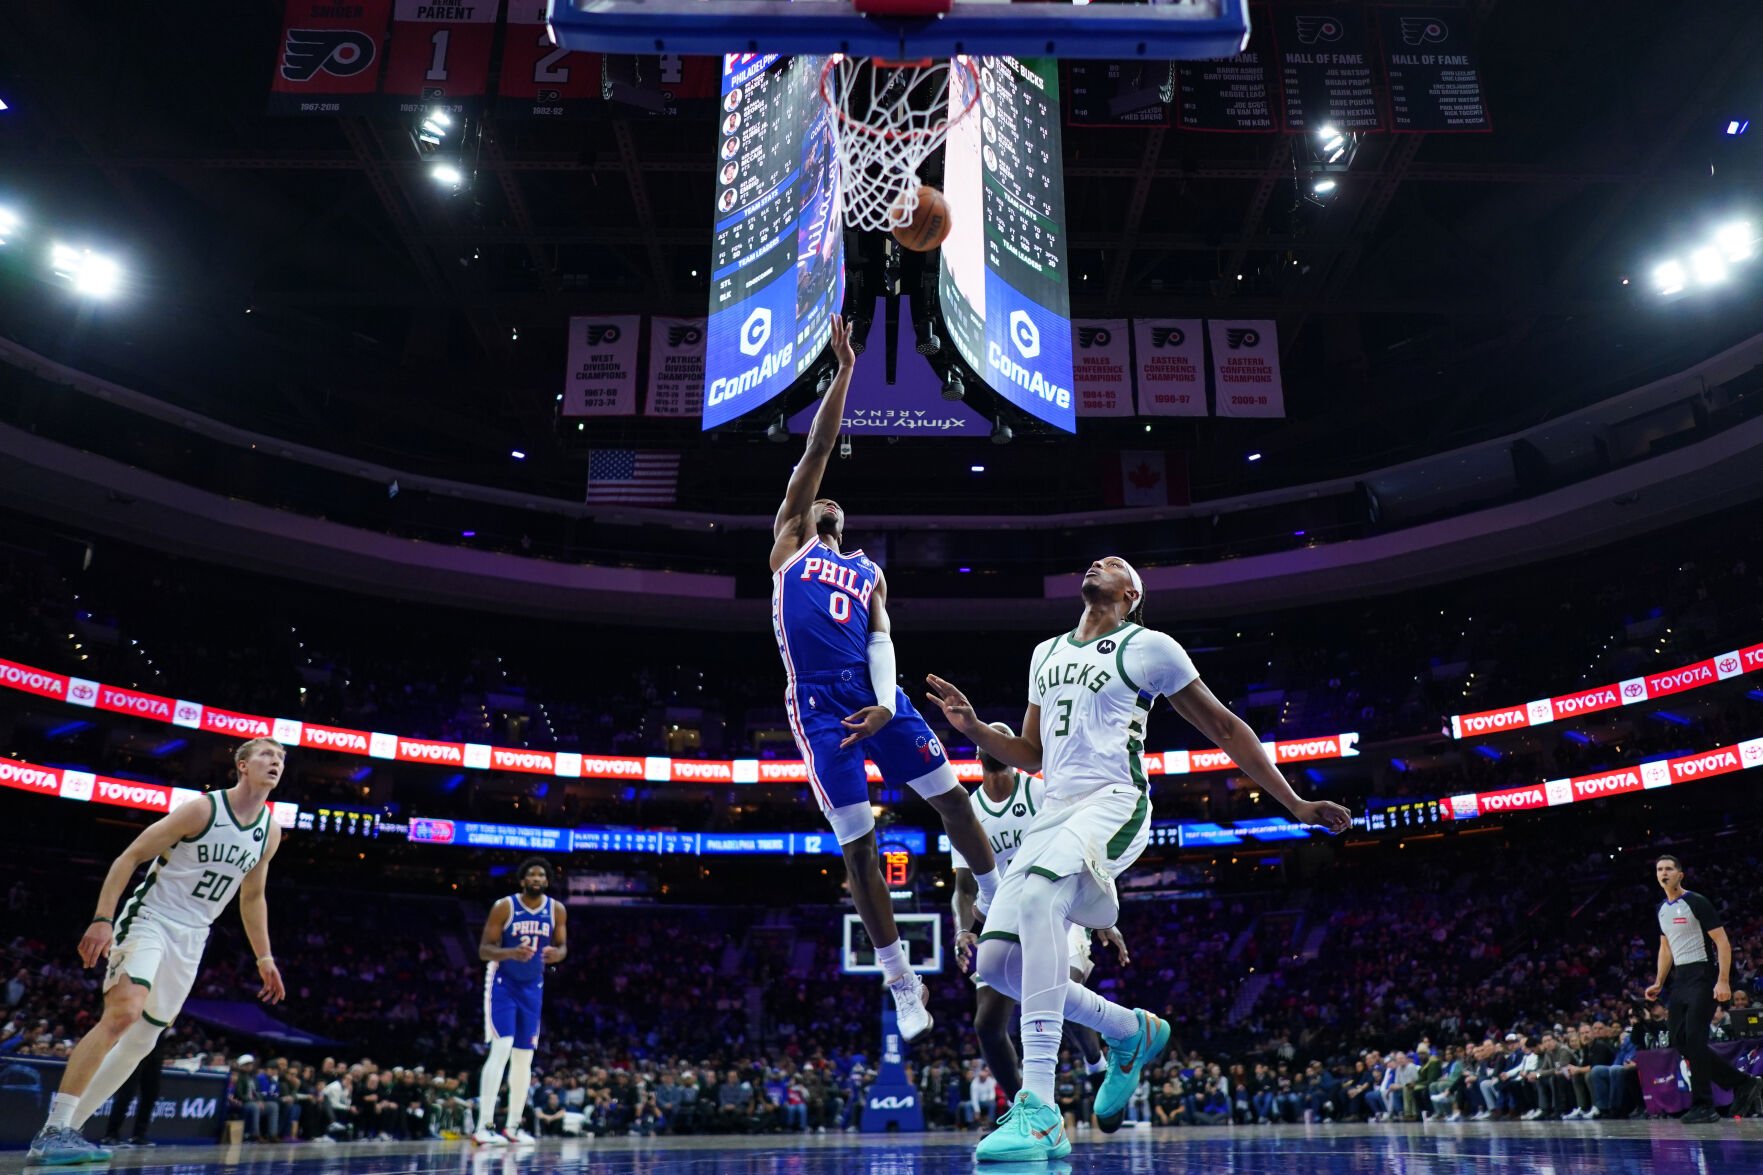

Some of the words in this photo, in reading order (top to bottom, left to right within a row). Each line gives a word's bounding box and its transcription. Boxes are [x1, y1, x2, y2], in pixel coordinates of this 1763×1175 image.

[417, 6, 475, 19] PARENT
[425, 30, 449, 81] 1
[1286, 53, 1314, 63] HALL
[1316, 53, 1330, 64] OF
[1332, 54, 1364, 64] FAME
[1391, 54, 1419, 65] HALL
[1421, 55, 1436, 65] OF
[1438, 55, 1469, 65] FAME
[1020, 64, 1044, 90] BUCKS
[301, 103, 340, 111] 1967-2016
[533, 107, 563, 115] 1982-92
[743, 101, 765, 118] GEORGE
[744, 202, 761, 217] TEAM
[761, 188, 779, 207] STATS
[1003, 191, 1019, 209] TEAM
[1019, 204, 1037, 221] STATS
[718, 231, 729, 240] AST
[1020, 216, 1028, 226] BLK
[1047, 233, 1055, 242] FLS
[719, 252, 726, 260] FG
[738, 253, 756, 268] TEAM
[755, 236, 780, 258] LEADERS
[989, 240, 999, 254] STL
[1003, 239, 1018, 257] TEAM
[1018, 251, 1043, 272] LEADERS
[1020, 242, 1030, 253] 100
[1048, 259, 1056, 268] 20
[990, 253, 1000, 267] BLK
[720, 278, 732, 289] STL
[719, 290, 732, 302] BLK
[583, 363, 621, 371] DIVISION
[591, 354, 614, 362] WEST
[1083, 357, 1110, 365] WALES
[1151, 356, 1189, 365] EASTERN
[1227, 358, 1264, 366] EASTERN
[576, 372, 627, 380] CHAMPIONS
[665, 364, 702, 372] DIVISION
[707, 342, 793, 407] ComAve
[988, 341, 1070, 409] ComAve
[1144, 365, 1197, 373] CONFERENCE
[1220, 366, 1272, 374] CONFERENCE
[1073, 374, 1122, 382] CHAMPIONS
[1146, 373, 1196, 382] CHAMPIONS
[1223, 374, 1272, 383] CHAMPIONS
[1155, 394, 1190, 404] 1996-97
[1231, 396, 1267, 405] 2009-10
[893, 417, 966, 430] xfinity
[829, 590, 852, 625] 0
[0, 664, 62, 694] TOYOTA
[1038, 663, 1112, 697] BUCKS
[1651, 666, 1713, 692] TOYOTA
[104, 690, 169, 717] TOYOTA
[1556, 690, 1616, 714] TOYOTA
[207, 712, 269, 735] TOYOTA
[1055, 700, 1073, 737] 3
[1464, 710, 1525, 732] TOYOTA
[305, 728, 367, 749] TOYOTA
[400, 741, 461, 762] TOYOTA
[1278, 740, 1337, 758] TOYOTA
[494, 750, 552, 770] TOYOTA
[585, 758, 643, 775] TOYOTA
[1673, 751, 1737, 778] TOYOTA
[0, 763, 58, 790] OYOTA
[673, 762, 731, 778] TOYOTA
[1575, 772, 1639, 796] TOYOTA
[98, 781, 167, 807] TOYOTA
[1481, 790, 1543, 811] TOYOTA
[706, 840, 756, 850] PHILADELPHIA
[804, 836, 822, 853] 12
[989, 829, 1023, 854] UCK
[197, 843, 256, 873] BUCKS
[886, 863, 907, 885] 13
[191, 870, 234, 902] 20
[511, 920, 550, 937] PHILA
[520, 935, 539, 953] 21
[181, 1098, 217, 1119] KIA
[870, 1096, 914, 1109] KIA
